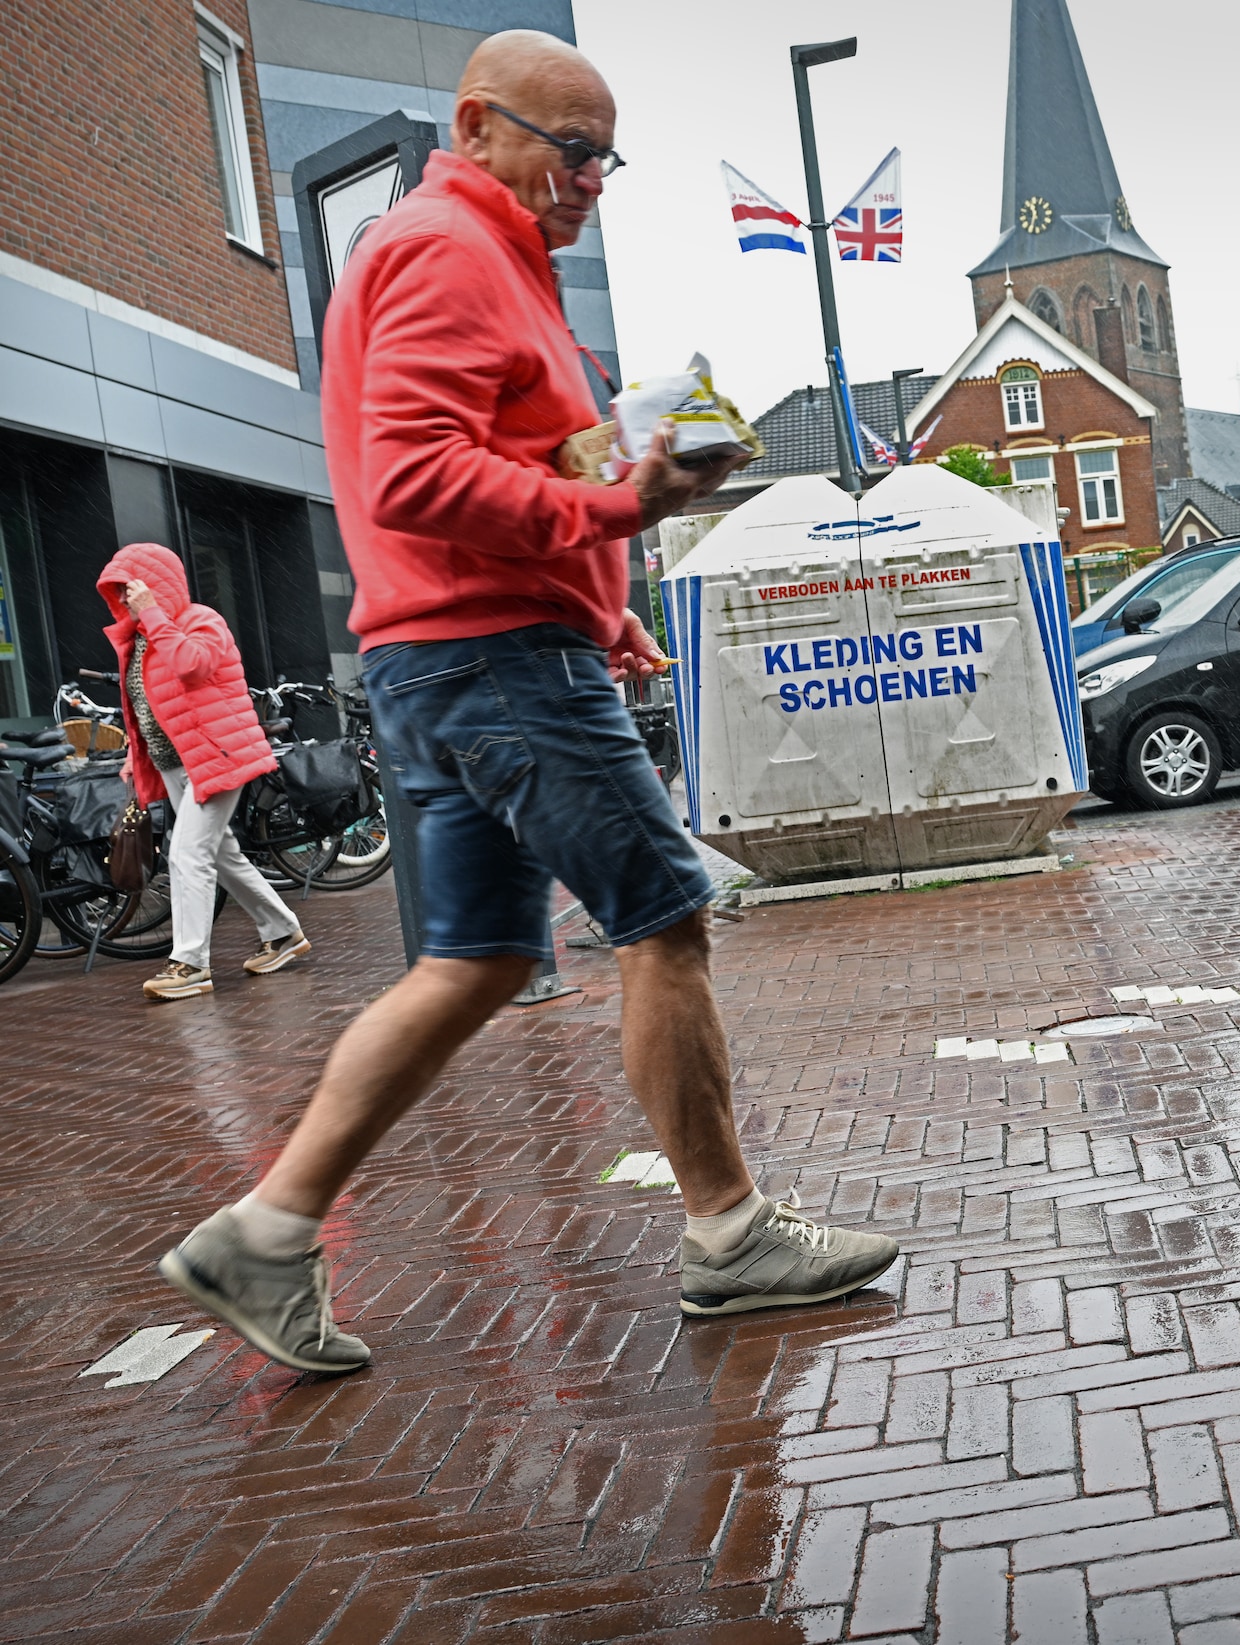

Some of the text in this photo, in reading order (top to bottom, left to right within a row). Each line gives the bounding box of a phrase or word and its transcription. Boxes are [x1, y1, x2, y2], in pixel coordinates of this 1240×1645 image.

[873, 193, 895, 203] 1945
[1008, 368, 1030, 380] 1912
[758, 567, 971, 601] VERBODEN AAN TE PLAKKEN
[764, 624, 983, 675] KLEDING EN
[780, 664, 977, 713] SCHOENEN
